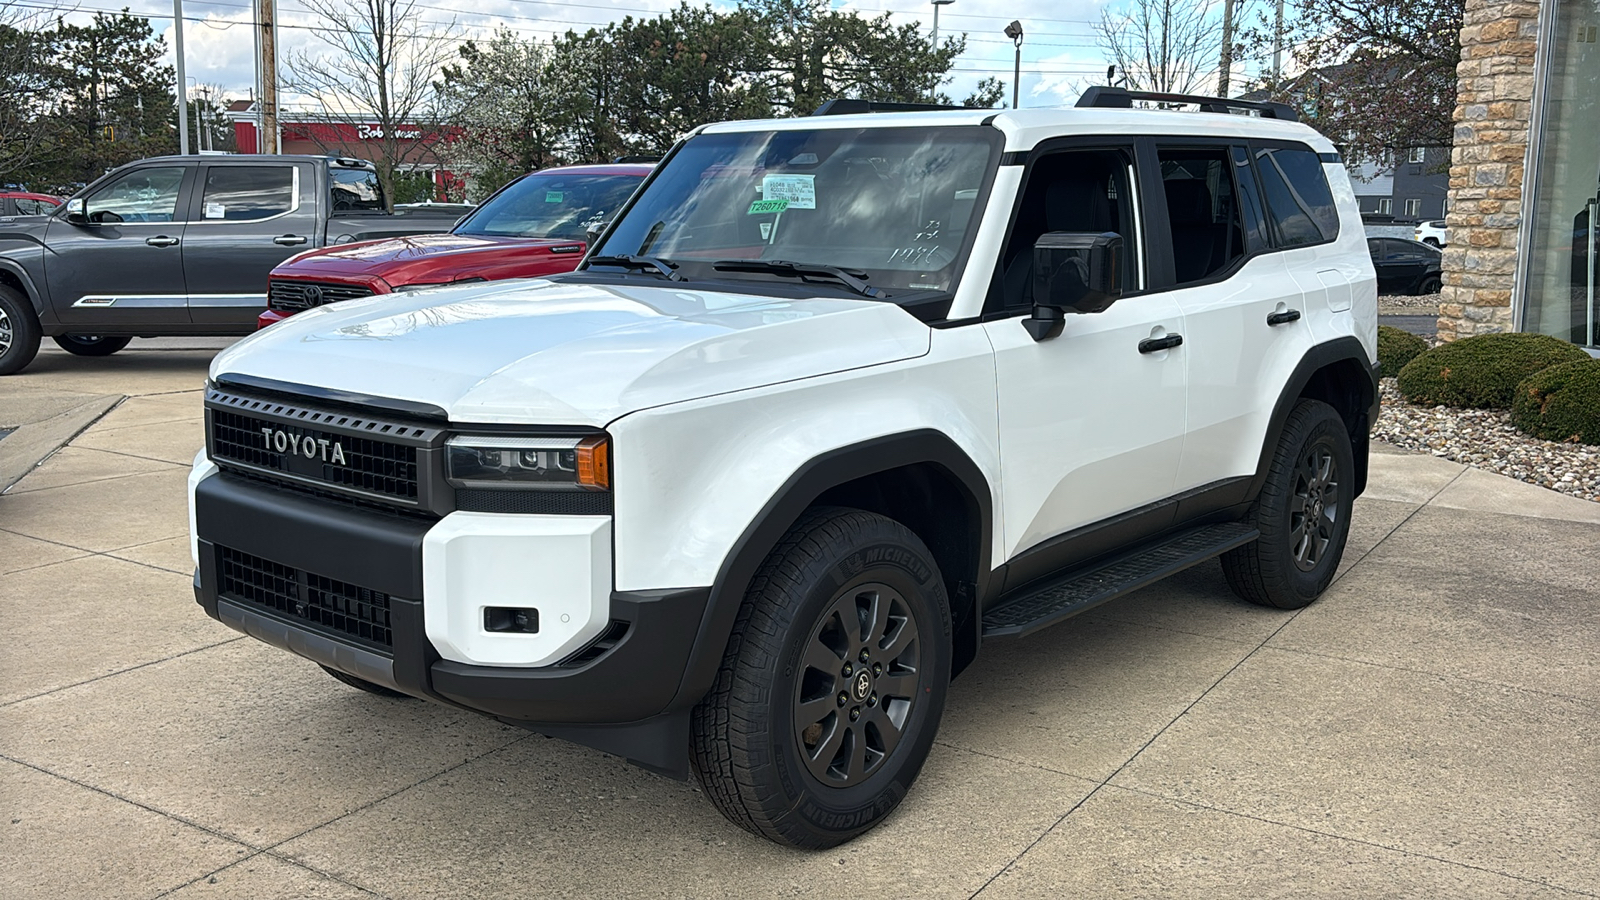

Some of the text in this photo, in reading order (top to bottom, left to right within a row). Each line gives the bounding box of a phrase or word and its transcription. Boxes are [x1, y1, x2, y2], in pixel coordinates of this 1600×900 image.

[358, 125, 384, 139] Bob
[751, 202, 788, 211] T260718
[262, 428, 346, 465] TOYOTA
[866, 547, 929, 580] MICHELIN
[802, 801, 874, 828] MICHELIN
